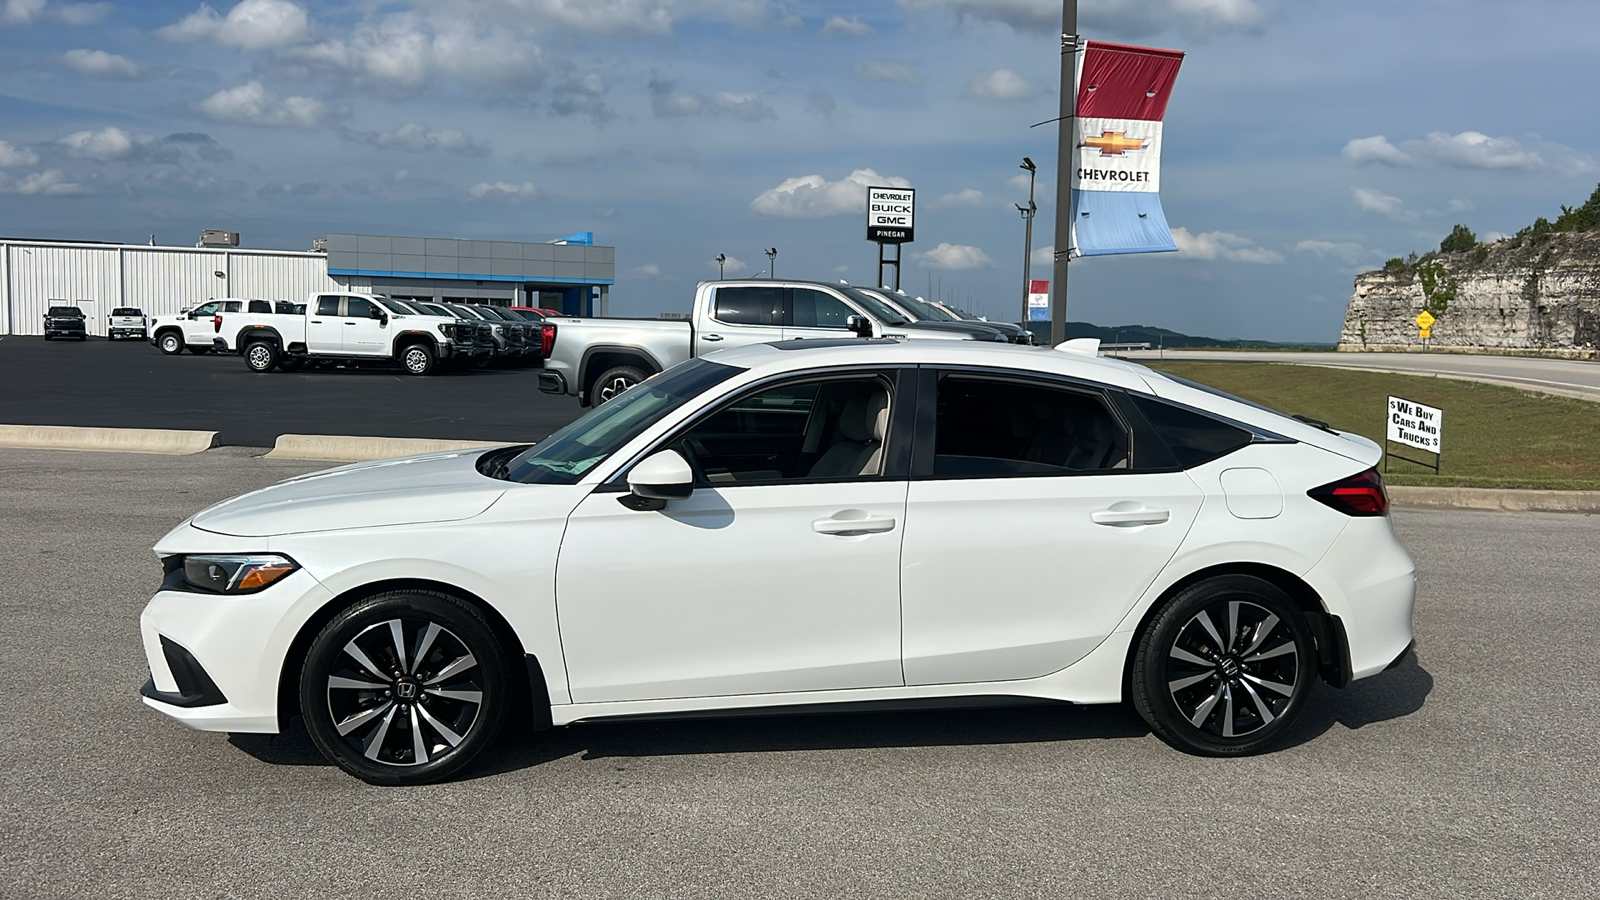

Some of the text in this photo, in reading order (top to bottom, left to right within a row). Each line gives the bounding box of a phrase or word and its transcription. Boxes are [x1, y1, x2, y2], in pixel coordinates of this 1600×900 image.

[1077, 168, 1149, 183] CHEVROLET
[873, 192, 911, 201] CHEVROLET
[872, 204, 911, 213] BUICK
[877, 216, 906, 225] GMC
[877, 230, 905, 238] PINEGAR
